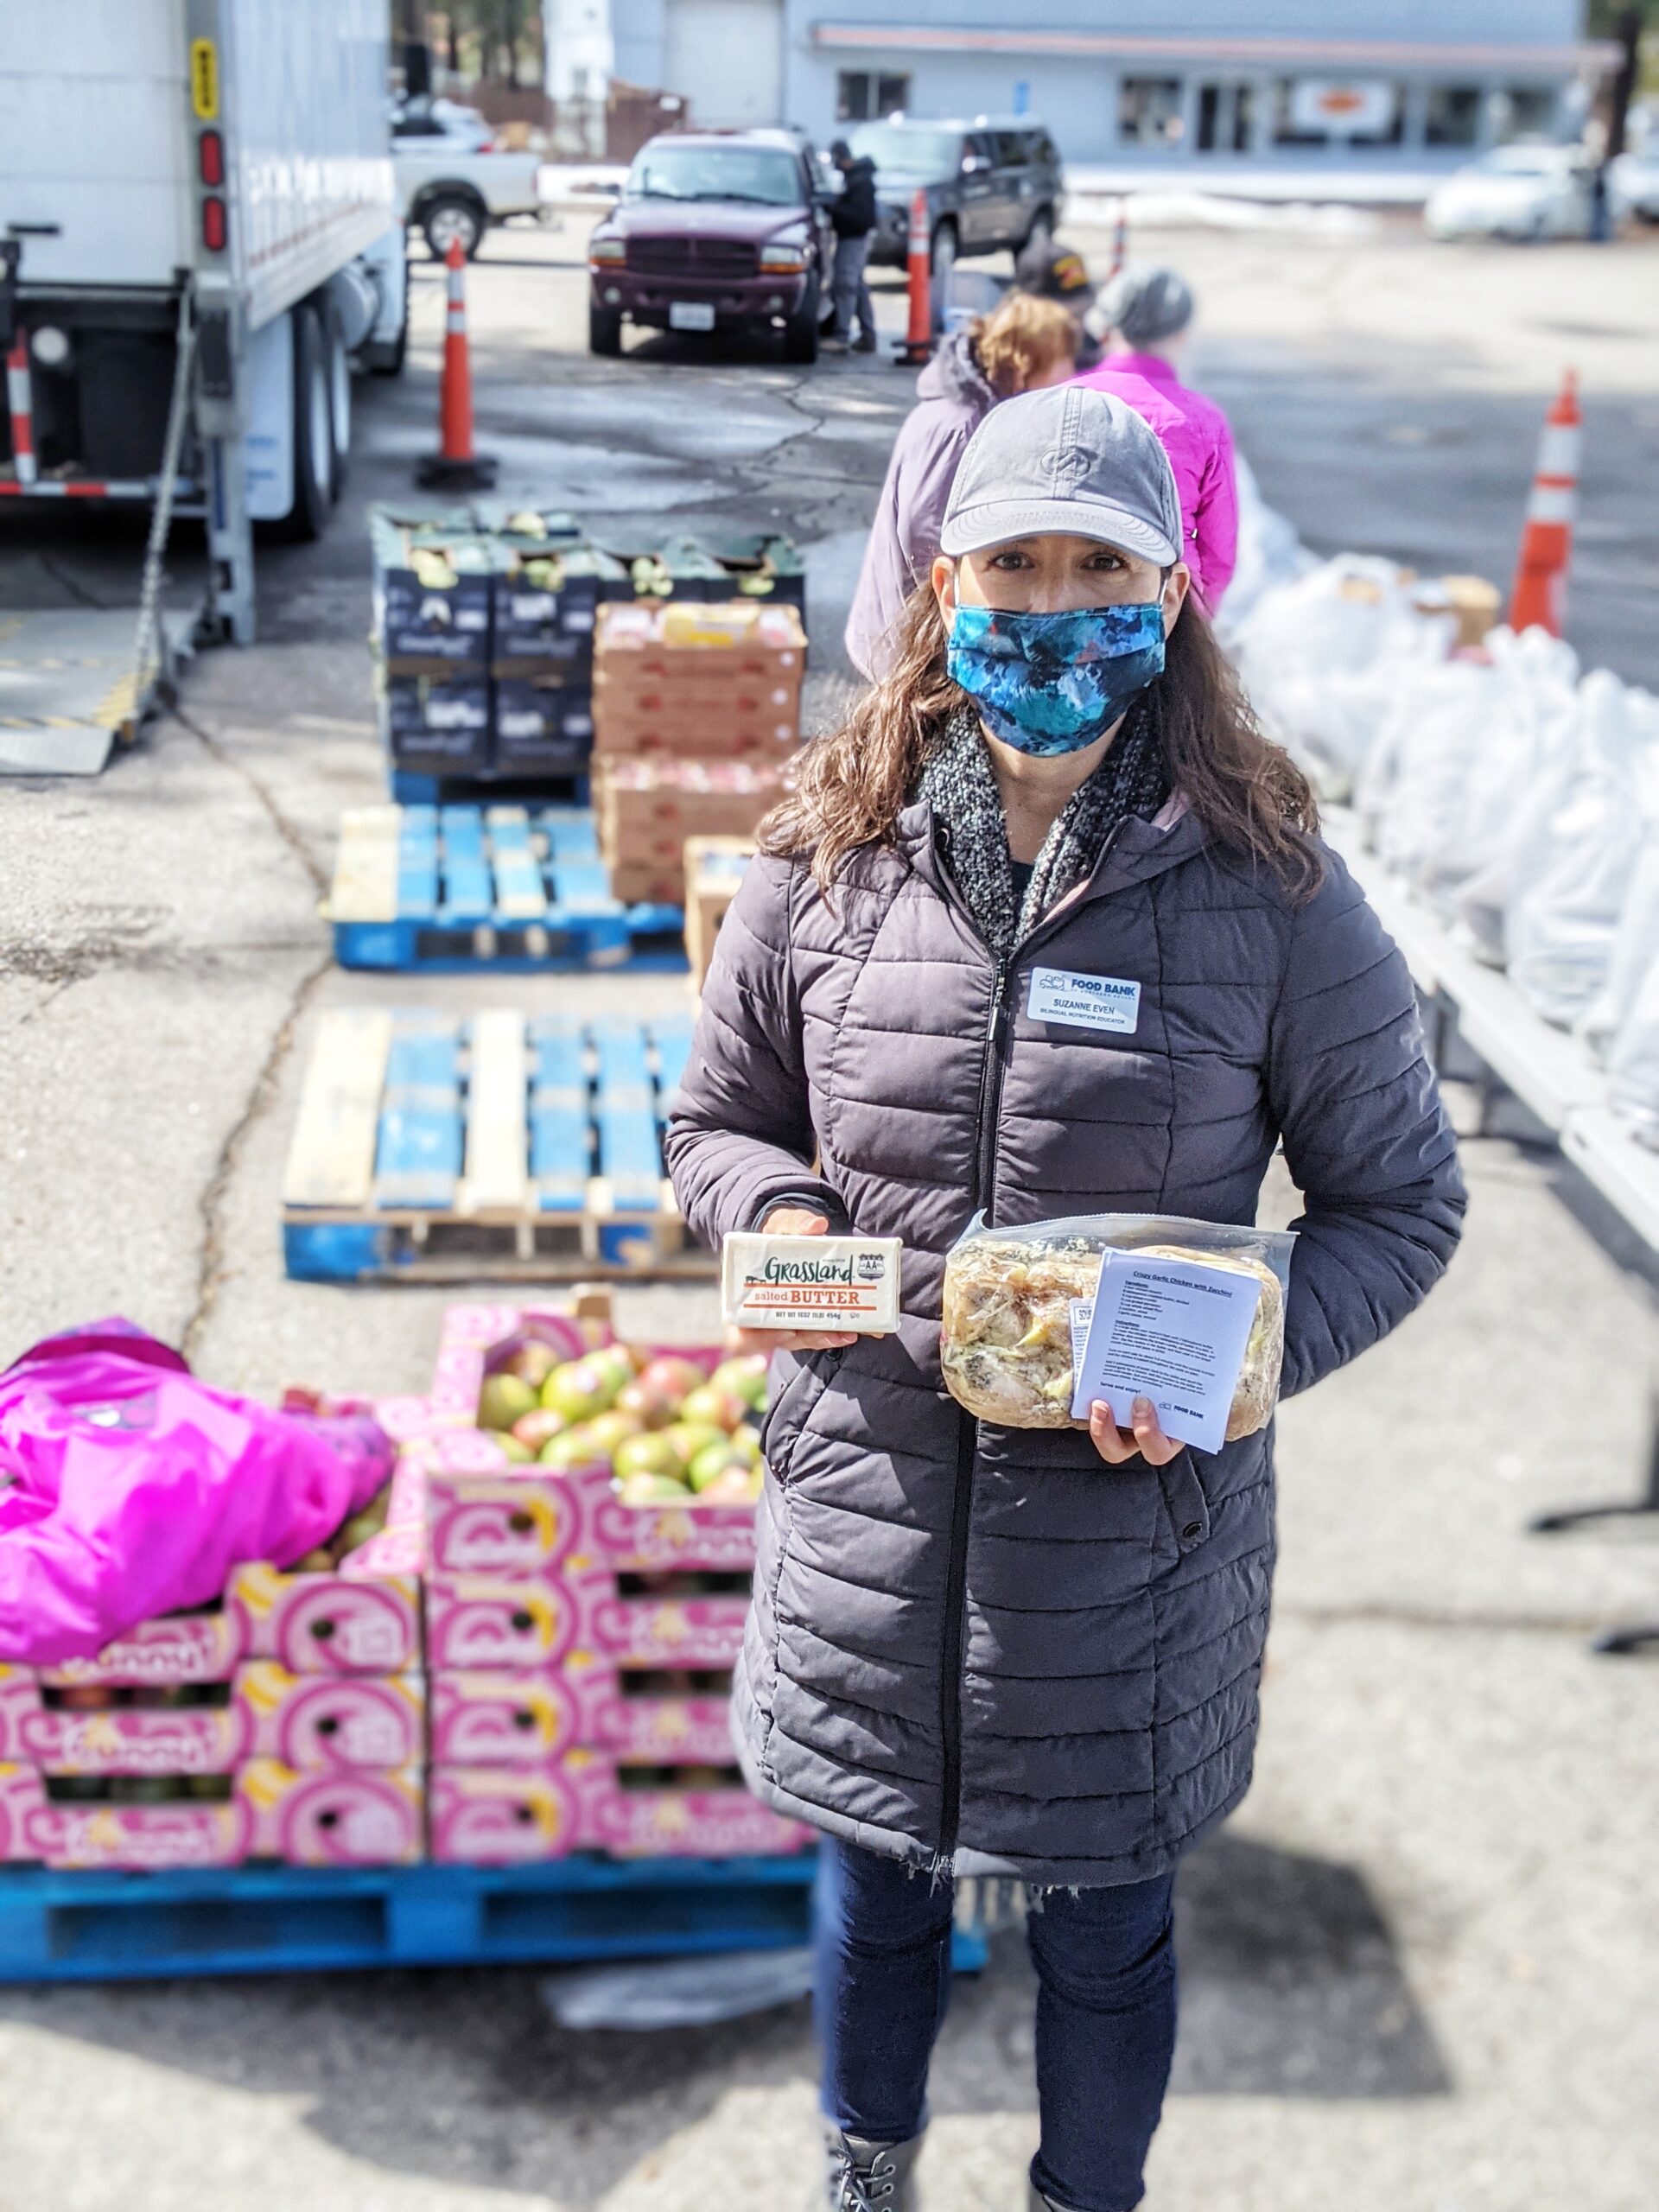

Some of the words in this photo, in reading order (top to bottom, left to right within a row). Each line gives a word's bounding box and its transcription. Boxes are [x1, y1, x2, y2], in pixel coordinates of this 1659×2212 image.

[1071, 979, 1102, 990] FOOD
[1104, 984, 1135, 996] BANK
[1053, 999, 1091, 1011] SUZANNE
[1093, 1005, 1115, 1014] EVEN
[1096, 1015, 1125, 1024] EDUCATOR
[1133, 1270, 1152, 1280] Crispy
[1152, 1274, 1168, 1283] Garlic
[1170, 1277, 1192, 1287] Chicken
[1208, 1286, 1233, 1297] Zucchini
[754, 1290, 787, 1301] salted
[791, 1290, 860, 1305] BUTTER
[1173, 1405, 1189, 1414] FOOD
[1190, 1409, 1205, 1419] BANK
